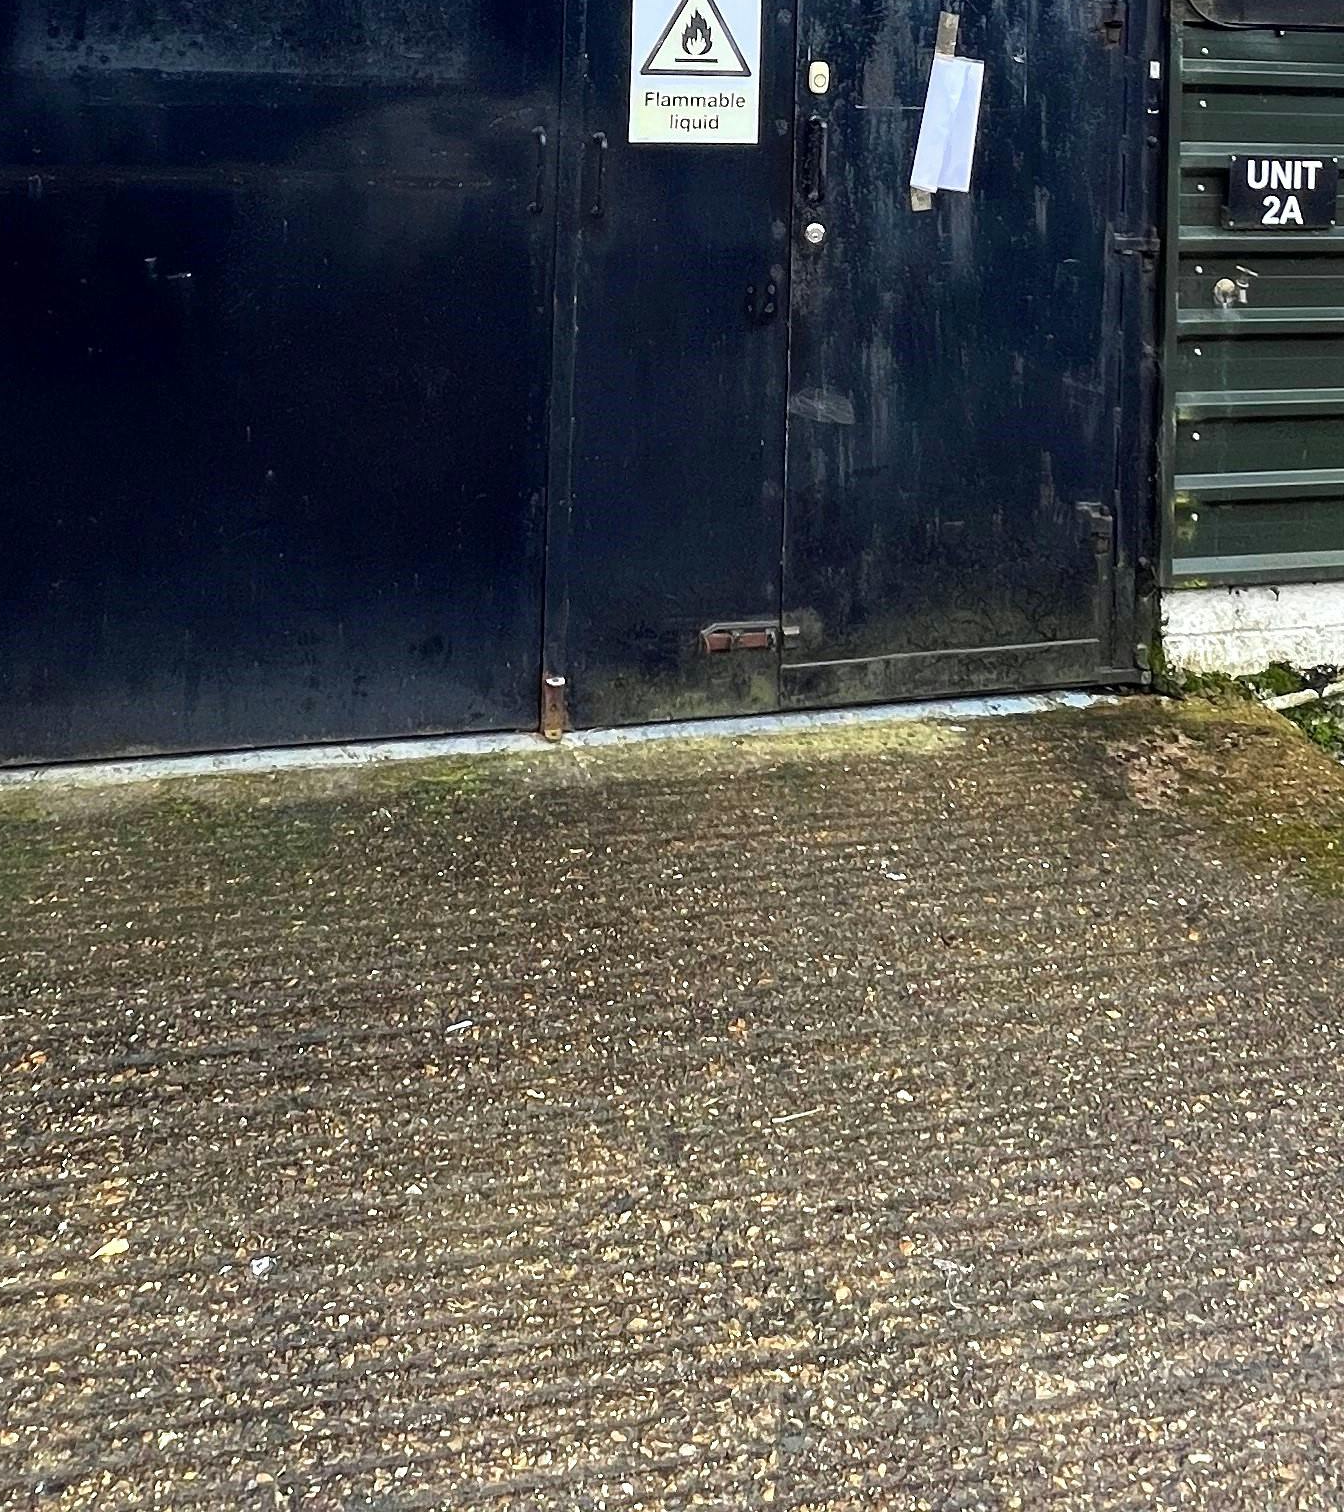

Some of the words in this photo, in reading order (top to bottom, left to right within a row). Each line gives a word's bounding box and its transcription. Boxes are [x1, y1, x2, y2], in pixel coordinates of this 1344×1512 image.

[644, 91, 746, 108] Flammable
[669, 114, 719, 132] liquid
[1247, 159, 1323, 190] UNIT
[1261, 195, 1304, 225] 2A
